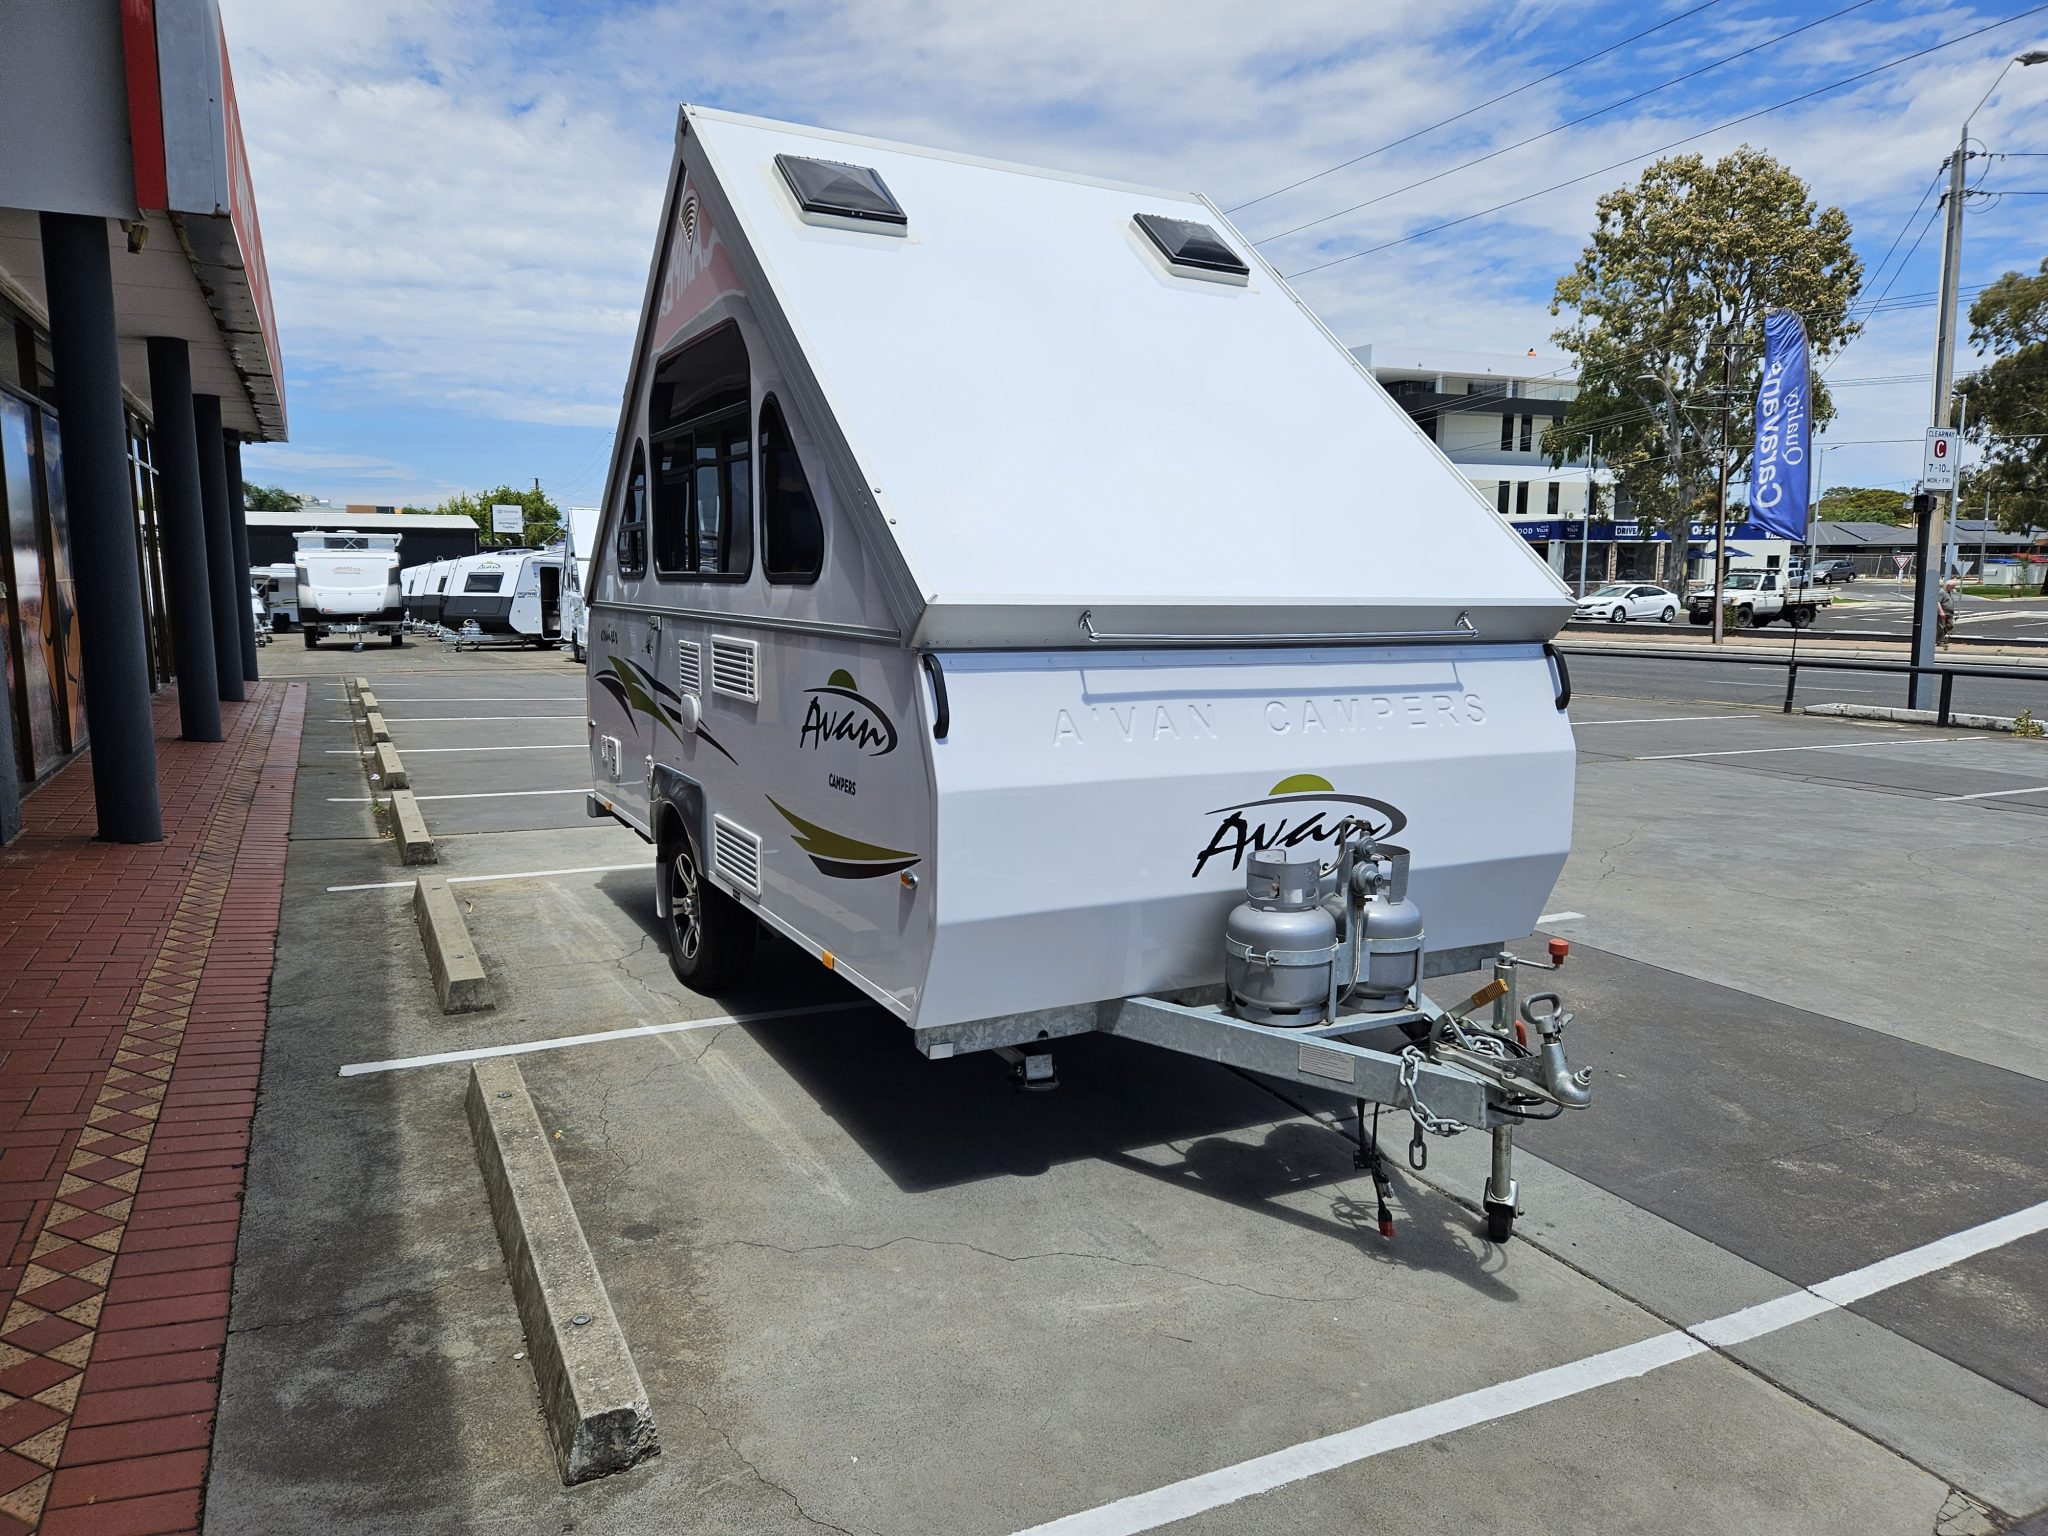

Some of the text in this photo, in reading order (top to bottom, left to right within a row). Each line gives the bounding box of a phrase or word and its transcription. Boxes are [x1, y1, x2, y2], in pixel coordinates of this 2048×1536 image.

[1929, 430, 1955, 438] CLEARWAY
[1937, 441, 1945, 457] C
[1616, 527, 1637, 535] DRIVE
[1263, 693, 1489, 735] CAMPERS
[828, 772, 857, 796] CAMPERS
